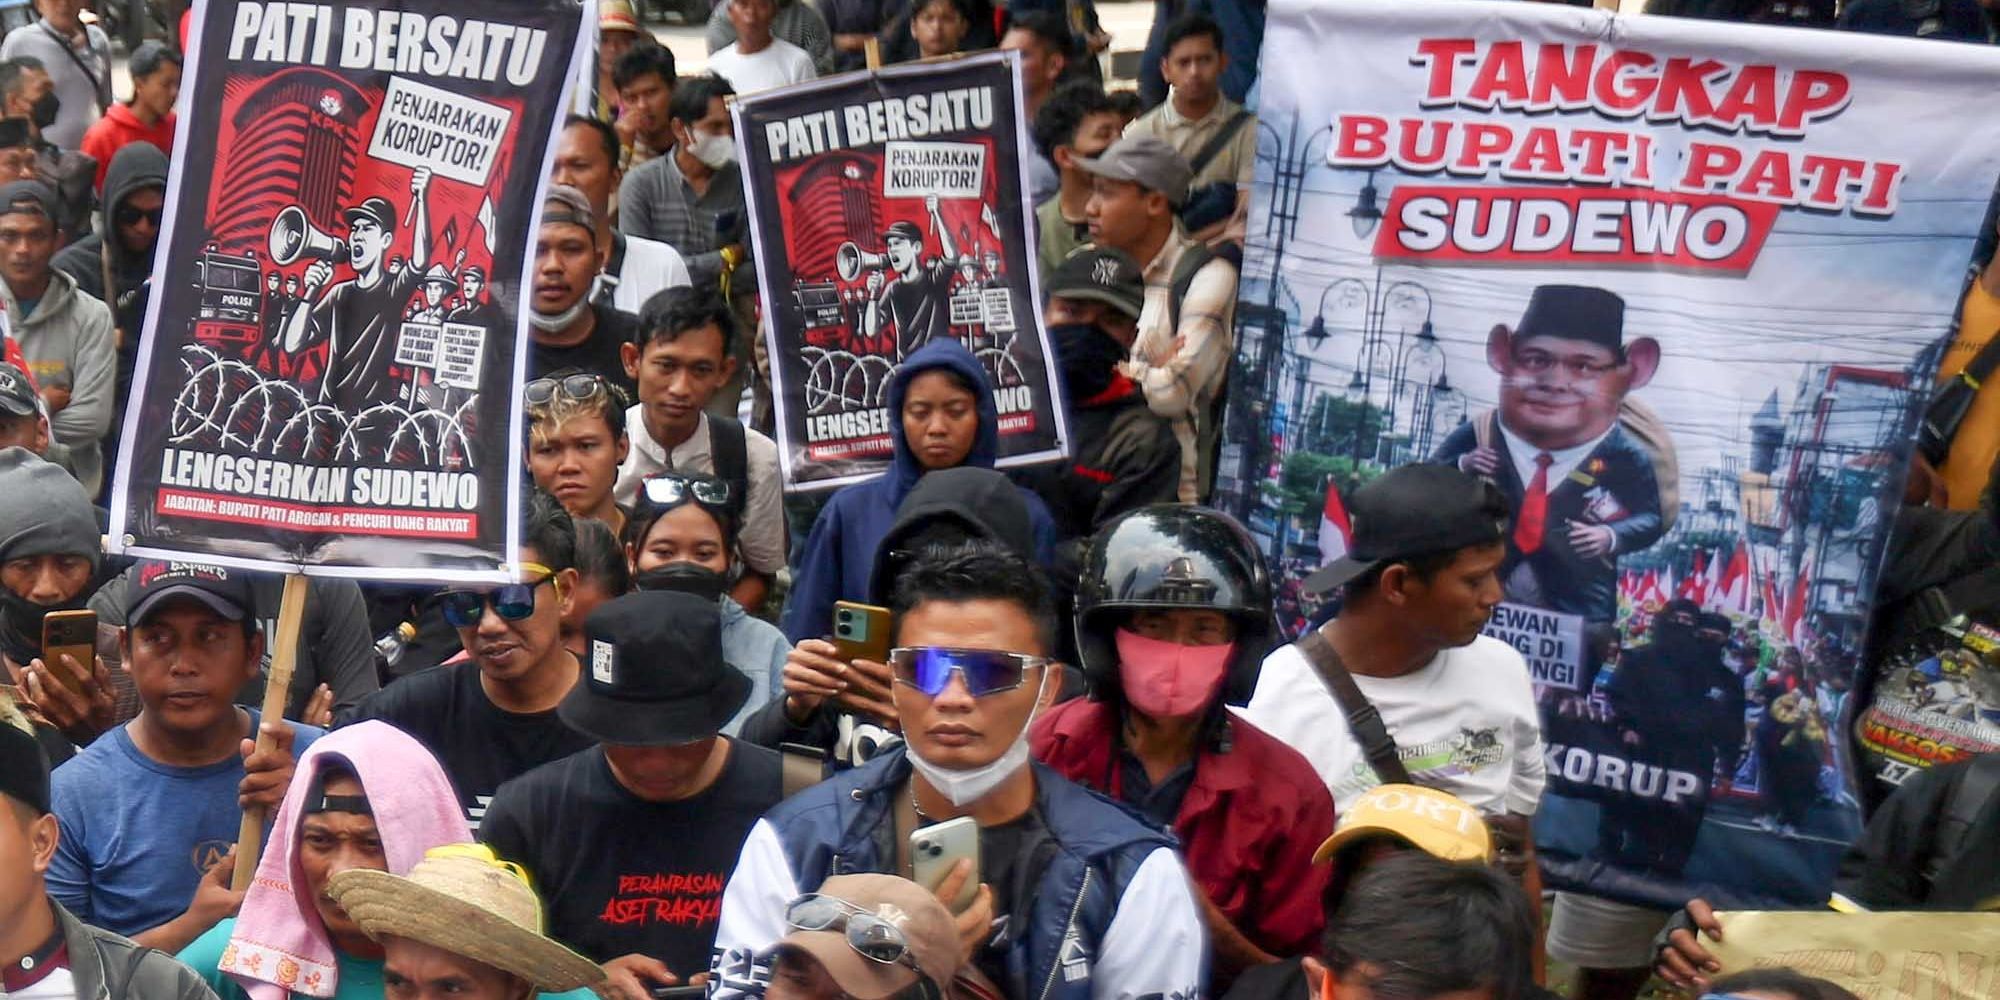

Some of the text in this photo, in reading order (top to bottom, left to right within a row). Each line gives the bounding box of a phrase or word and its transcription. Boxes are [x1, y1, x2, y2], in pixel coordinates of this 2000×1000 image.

[228, 1, 548, 87] PATI BERSATU
[1414, 37, 1852, 132] TANGKAP
[390, 89, 501, 142] PENJARAKAN
[765, 86, 994, 164] PATI BERSATU
[381, 118, 490, 173] KORUPTOR!
[891, 149, 980, 169] PENJARAKAN
[1333, 114, 1902, 211] BUPATI PATI
[890, 169, 977, 190] KORUPTOR!
[1397, 195, 1750, 261] SUDEWO
[222, 295, 253, 307] POLISI
[160, 448, 479, 511] LENGSERKAN SUDEWO
[163, 493, 470, 534] JABATAN: BUPATI PATI AROGAN & PENCURI UANG RAKYAT
[1490, 606, 1560, 637] EWAN
[1484, 627, 1564, 660] ANG DI
[1526, 658, 1575, 685] NGI
[617, 872, 724, 895] PERAMPASAN
[598, 896, 721, 928] ASET RAKYA
